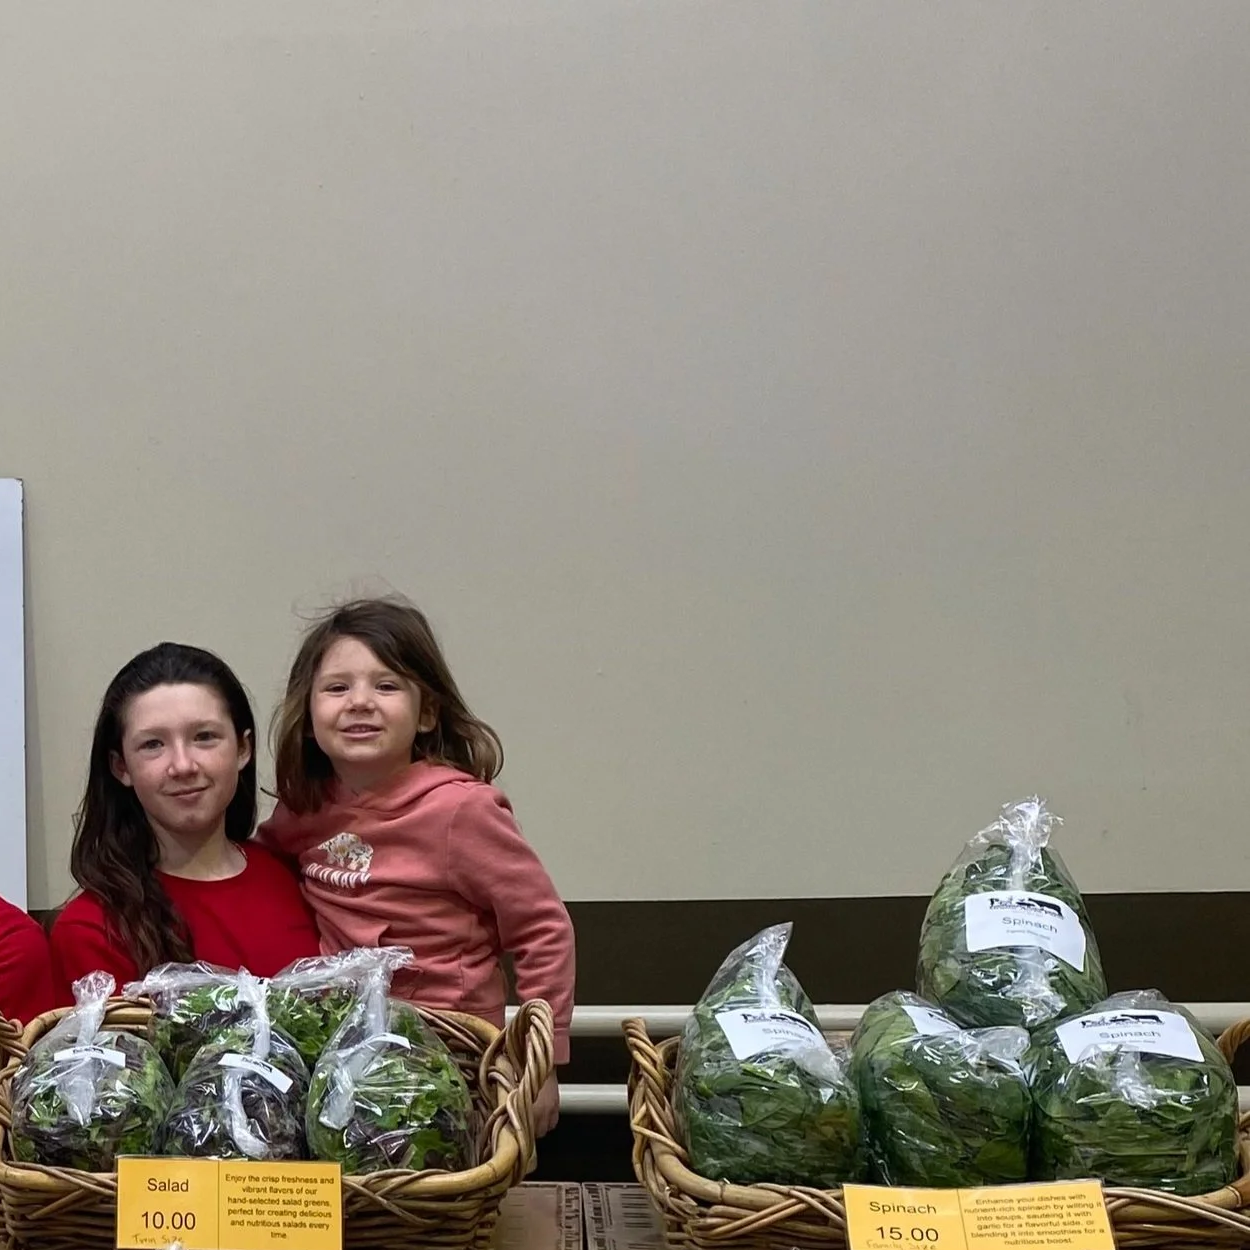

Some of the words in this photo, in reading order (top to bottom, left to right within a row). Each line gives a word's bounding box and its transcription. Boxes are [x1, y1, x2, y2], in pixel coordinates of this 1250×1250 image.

[1002, 917, 1058, 933] Spinach
[1099, 1029, 1161, 1041] Spinach
[147, 1178, 189, 1192] Salad
[225, 1174, 246, 1184] Enjoy
[248, 1175, 260, 1183] the
[262, 1176, 280, 1185] crisp
[282, 1176, 318, 1184] freshness
[227, 1207, 254, 1217] perfect
[256, 1208, 266, 1216] for
[268, 1209, 297, 1218] creating
[299, 1210, 332, 1218] delicious
[869, 1201, 937, 1218] Spinach
[141, 1211, 196, 1230] 10.00
[230, 1219, 244, 1227] and
[246, 1219, 281, 1227] nutritious
[283, 1220, 307, 1228] salads
[309, 1222, 329, 1231] every
[876, 1227, 939, 1242] 15.00
[866, 1240, 903, 1250] Family
